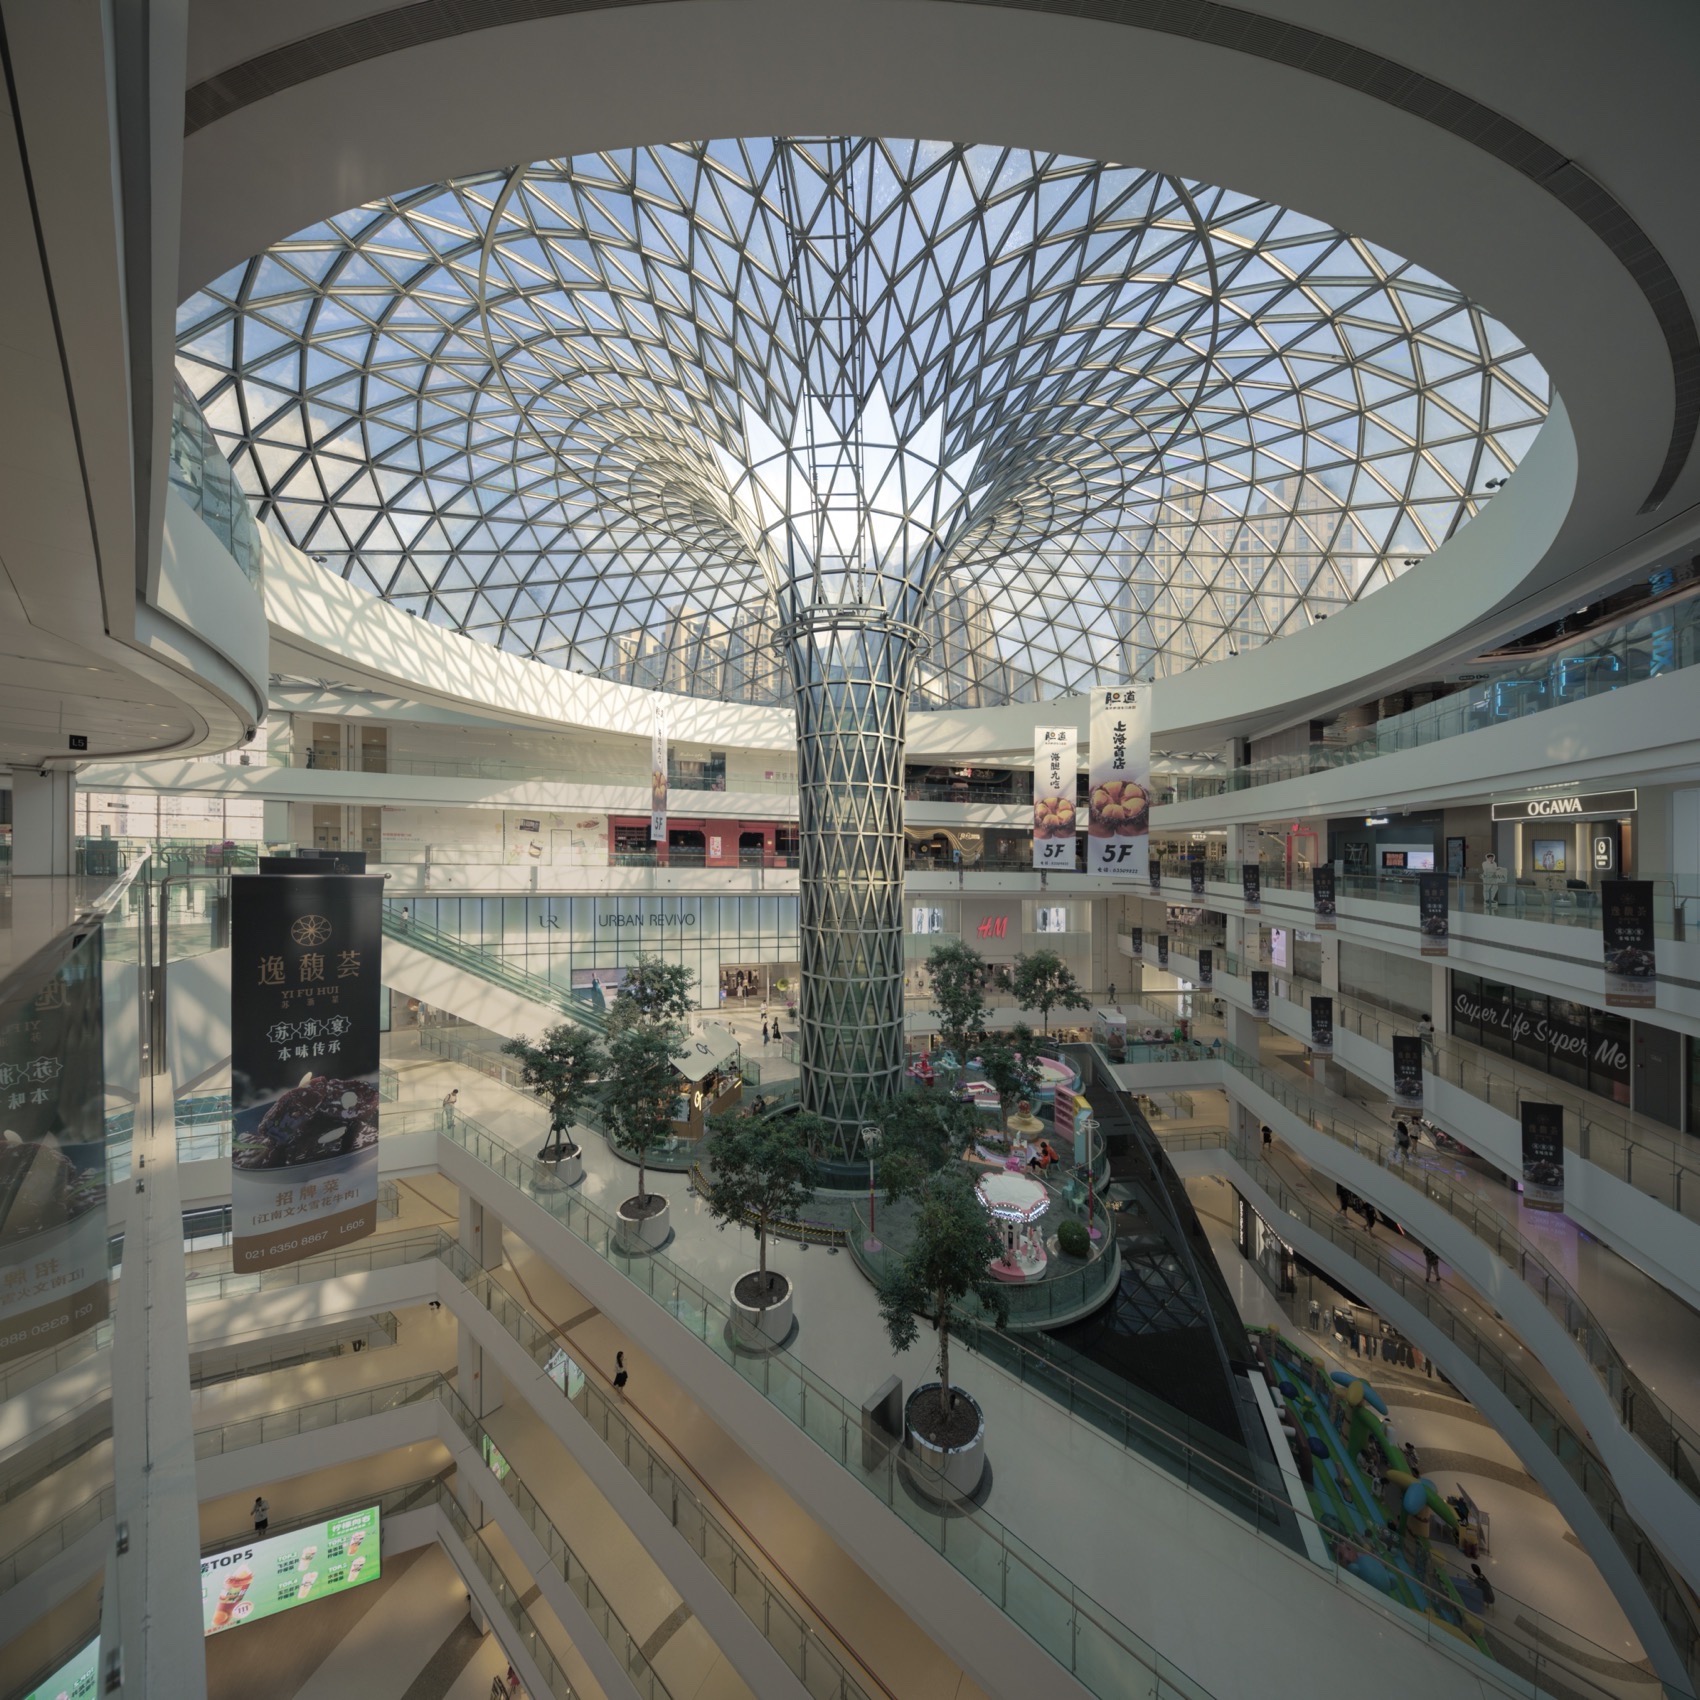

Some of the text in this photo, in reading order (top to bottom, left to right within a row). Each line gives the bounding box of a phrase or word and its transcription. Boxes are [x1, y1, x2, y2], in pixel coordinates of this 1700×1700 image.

[72, 738, 85, 747] L5
[1113, 721, 1127, 769] 上海首店
[1527, 798, 1582, 816] OGAWA
[1044, 844, 1065, 857] 5F
[1102, 844, 1133, 863] 5F
[598, 913, 695, 927] URBAN REVIVO
[258, 950, 361, 986] 逸馥荟
[281, 986, 339, 999] YI FU HUI
[1455, 994, 1628, 1070] Super Life Super Me
[278, 1040, 341, 1061] 本味传承
[275, 1178, 340, 1207] 招牌菜
[245, 1219, 365, 1260] 021 6350 8867 L605
